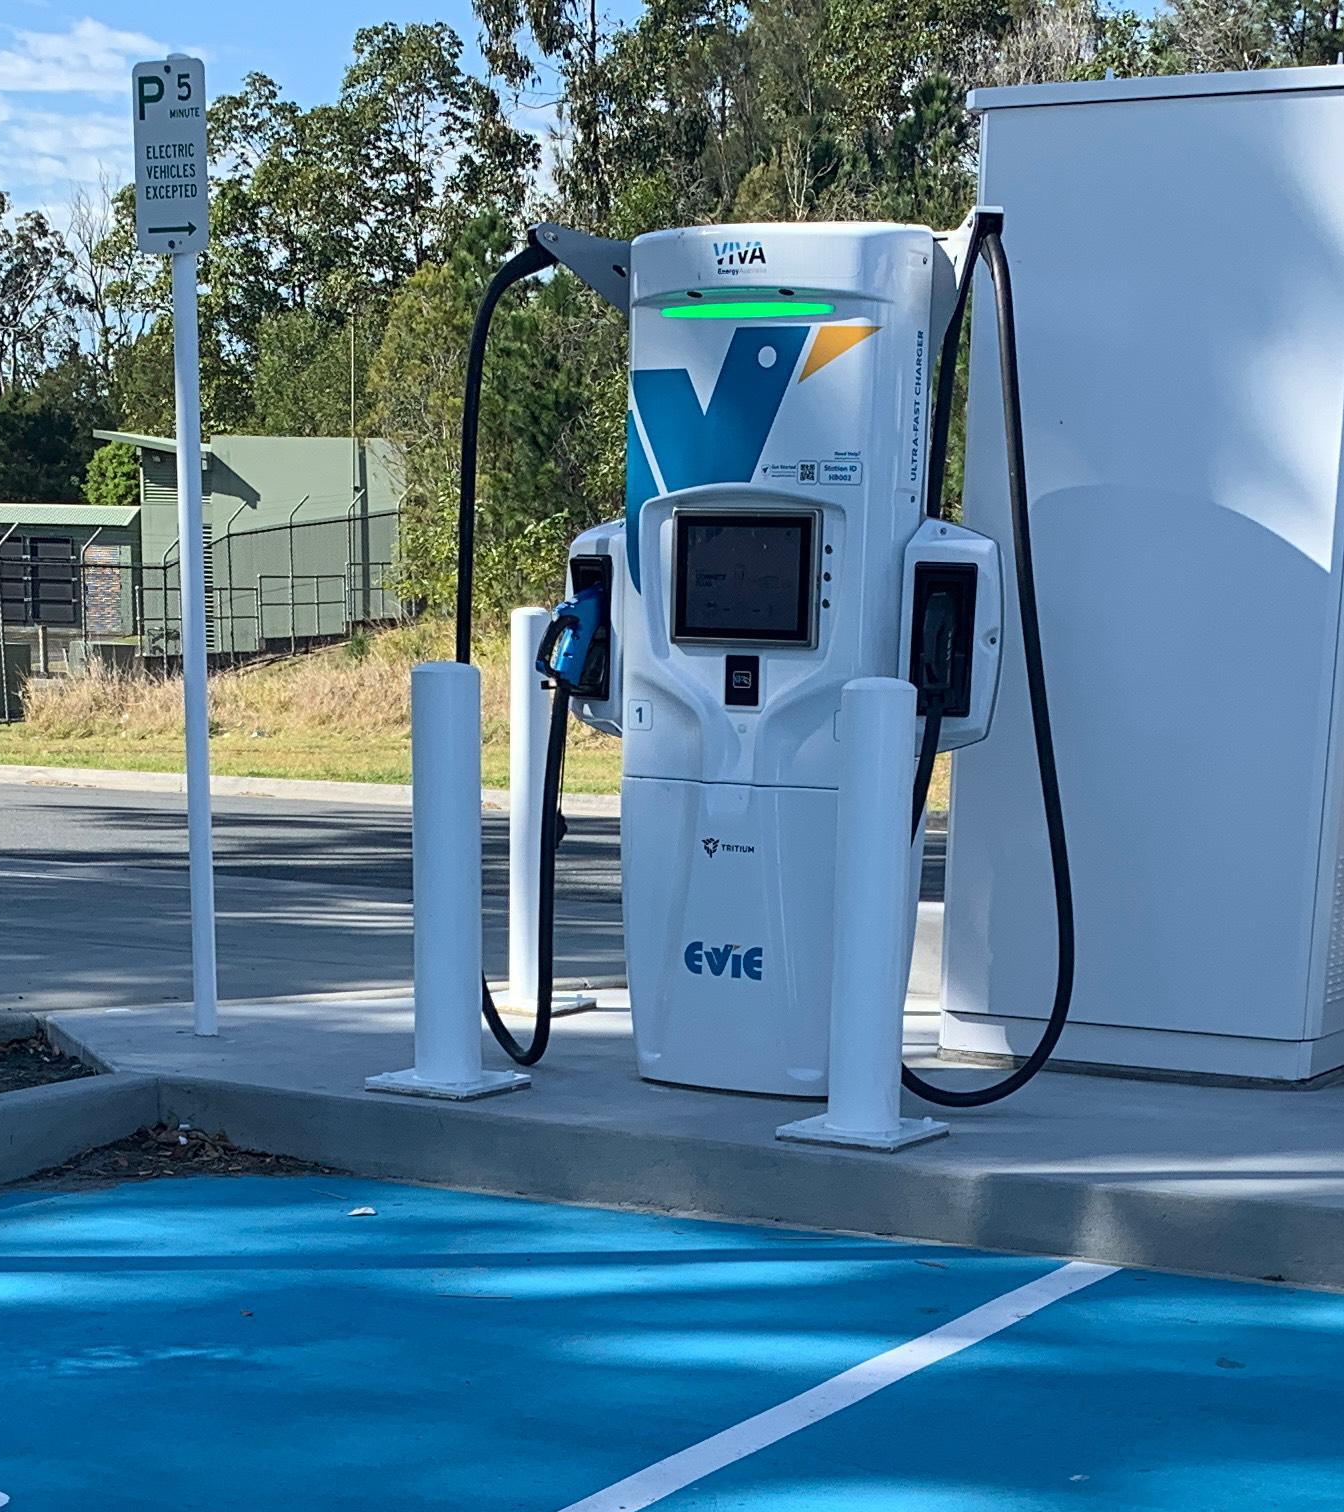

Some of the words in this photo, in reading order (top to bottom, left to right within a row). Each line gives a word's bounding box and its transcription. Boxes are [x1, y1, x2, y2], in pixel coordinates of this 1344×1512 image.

[138, 76, 164, 120] P
[177, 73, 192, 101] 5
[170, 106, 200, 119] MINUTE
[146, 143, 195, 160] ELECTRIC
[146, 163, 196, 180] VEHICLES
[145, 183, 197, 200] EXCEPTED
[713, 241, 766, 265] VIVA
[914, 330, 924, 396] CHARGER
[911, 400, 921, 481] ULTRA-FAST
[635, 706, 643, 723] 1
[721, 844, 755, 853] TRITIUM
